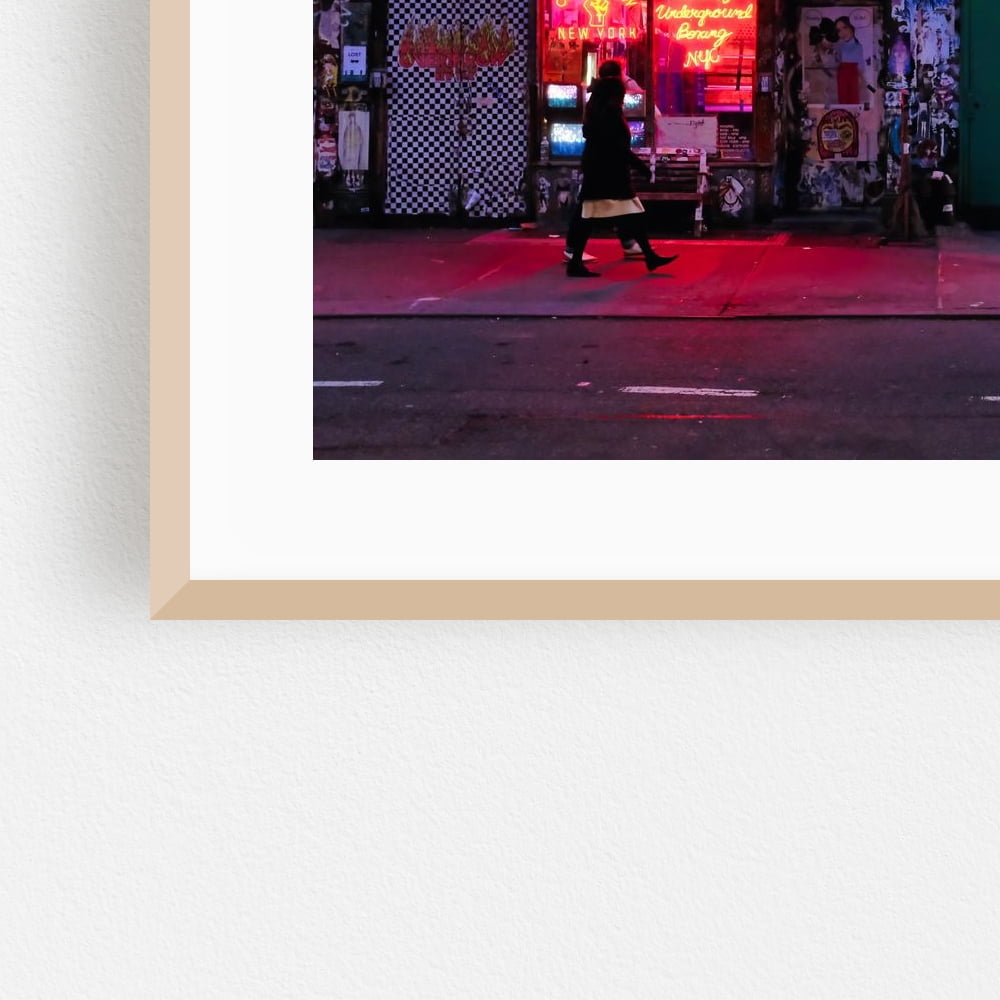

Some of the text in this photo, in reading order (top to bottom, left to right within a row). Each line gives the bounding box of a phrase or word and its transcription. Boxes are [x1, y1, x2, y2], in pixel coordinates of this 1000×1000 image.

[655, 3, 754, 27] Underground
[558, 27, 637, 40] NEW YORK
[675, 22, 734, 48] Boxing
[683, 47, 720, 70] NYC
